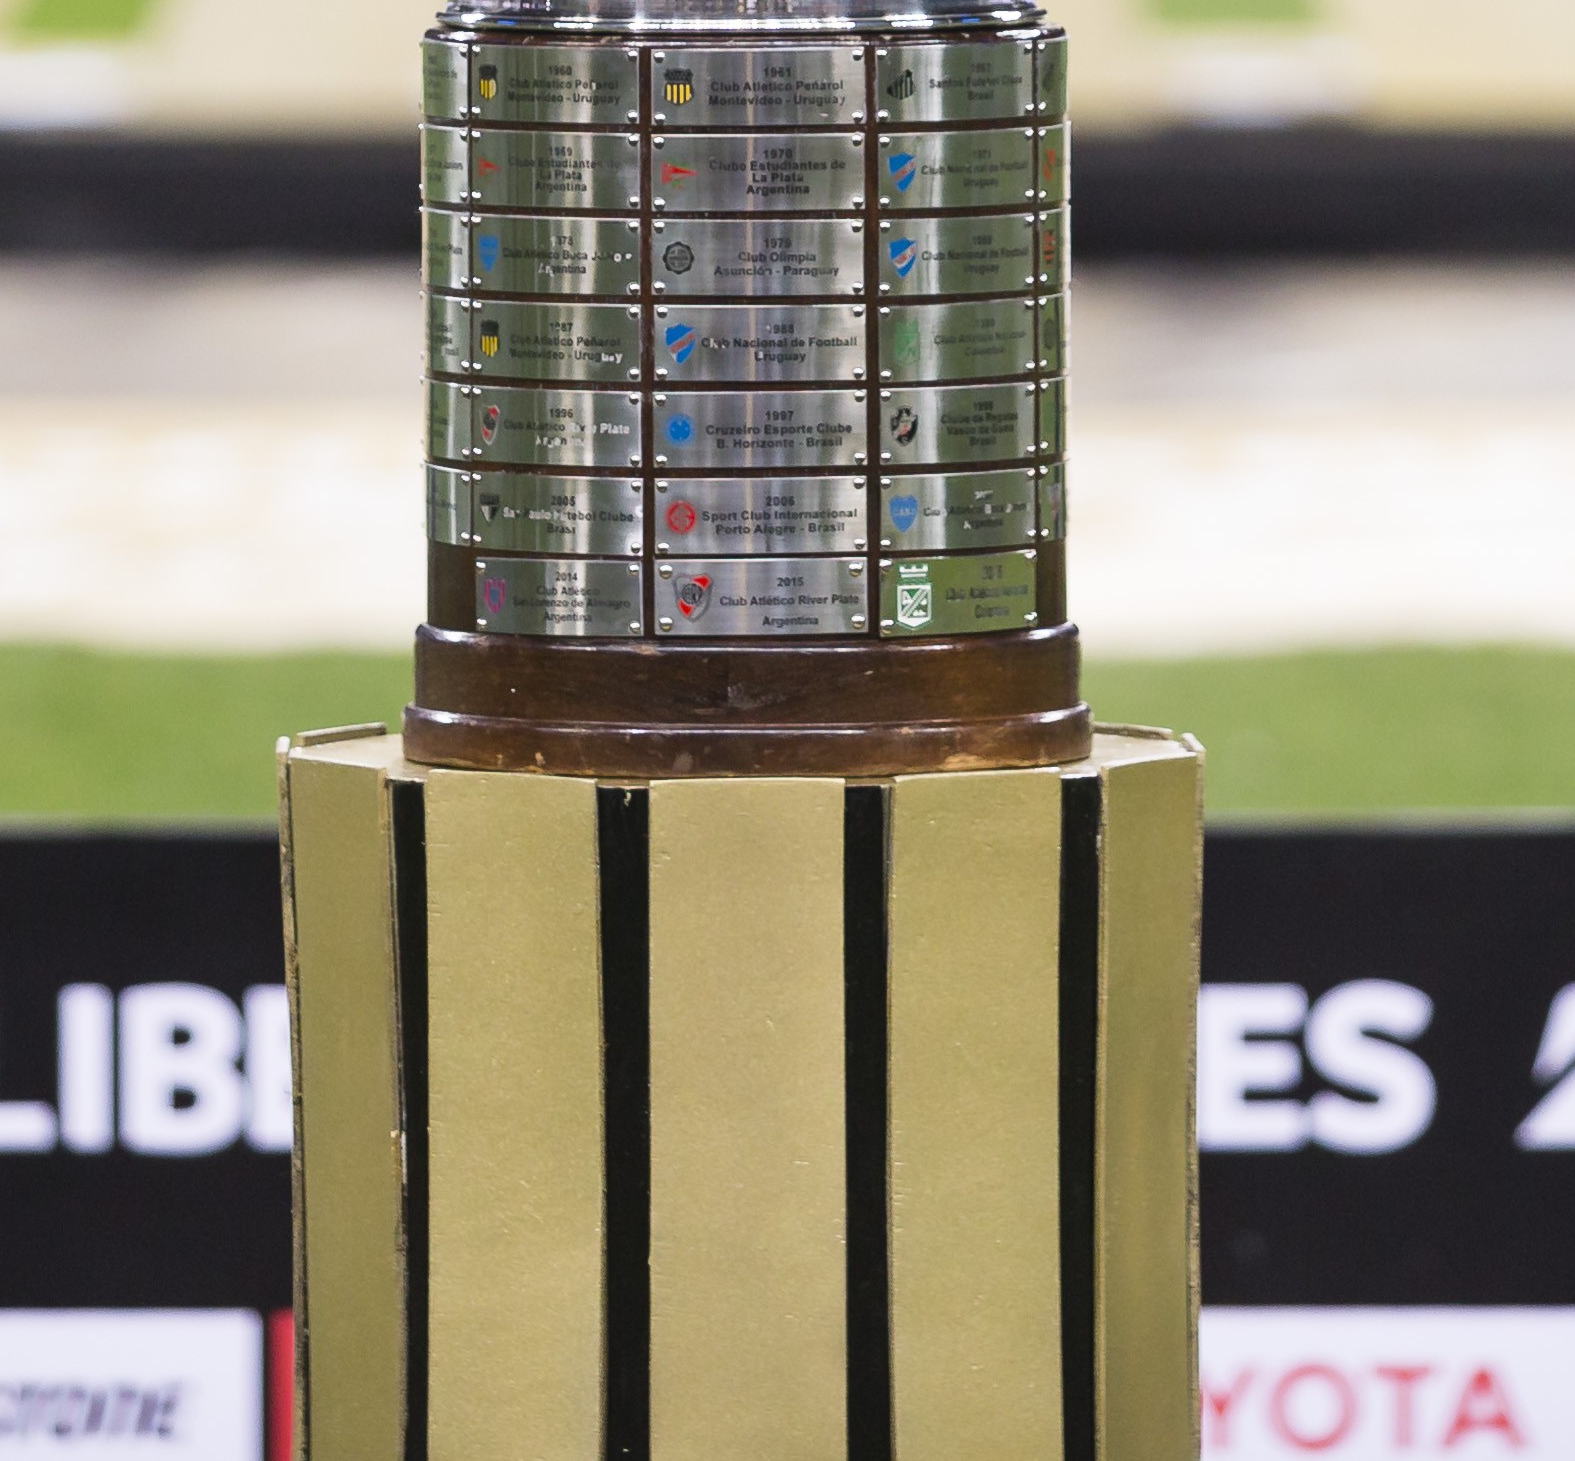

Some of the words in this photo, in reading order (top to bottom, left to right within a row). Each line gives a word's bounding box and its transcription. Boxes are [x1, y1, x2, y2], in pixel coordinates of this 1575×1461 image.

[710, 81, 739, 91] Club
[574, 94, 620, 105] Uruguay
[708, 95, 782, 106] Montevideo
[794, 95, 845, 107] Uruguay
[750, 161, 827, 170] Estudiantes
[555, 170, 582, 180] Plata
[752, 173, 767, 183] La
[771, 173, 804, 183] Plata
[536, 181, 587, 193] Argentina
[746, 185, 810, 196] Argentina
[738, 252, 767, 261] Club
[770, 251, 816, 264] Olimpia
[783, 266, 839, 277] Paraguay
[733, 338, 787, 348] Nacional
[790, 338, 805, 347] de
[808, 337, 857, 347] Football
[754, 351, 806, 363] Uruguay
[765, 411, 794, 421] 1997
[706, 424, 760, 435] Cruzeiro
[764, 423, 813, 435] Esporte
[733, 438, 795, 448] Horizonte
[806, 437, 843, 447] Brasil
[765, 496, 795, 506] 2006
[702, 510, 737, 522] Sport
[741, 510, 771, 520] Club
[775, 508, 857, 519] Internacional
[716, 524, 749, 535] Porto
[754, 523, 795, 535] Alegre
[808, 522, 845, 533] Brasil
[777, 577, 804, 587] 2015
[720, 595, 747, 606] Club
[798, 594, 828, 605] River
[831, 593, 859, 604] Plate
[762, 615, 819, 628] Argentina
[1201, 1362, 1527, 1450] YOTA
